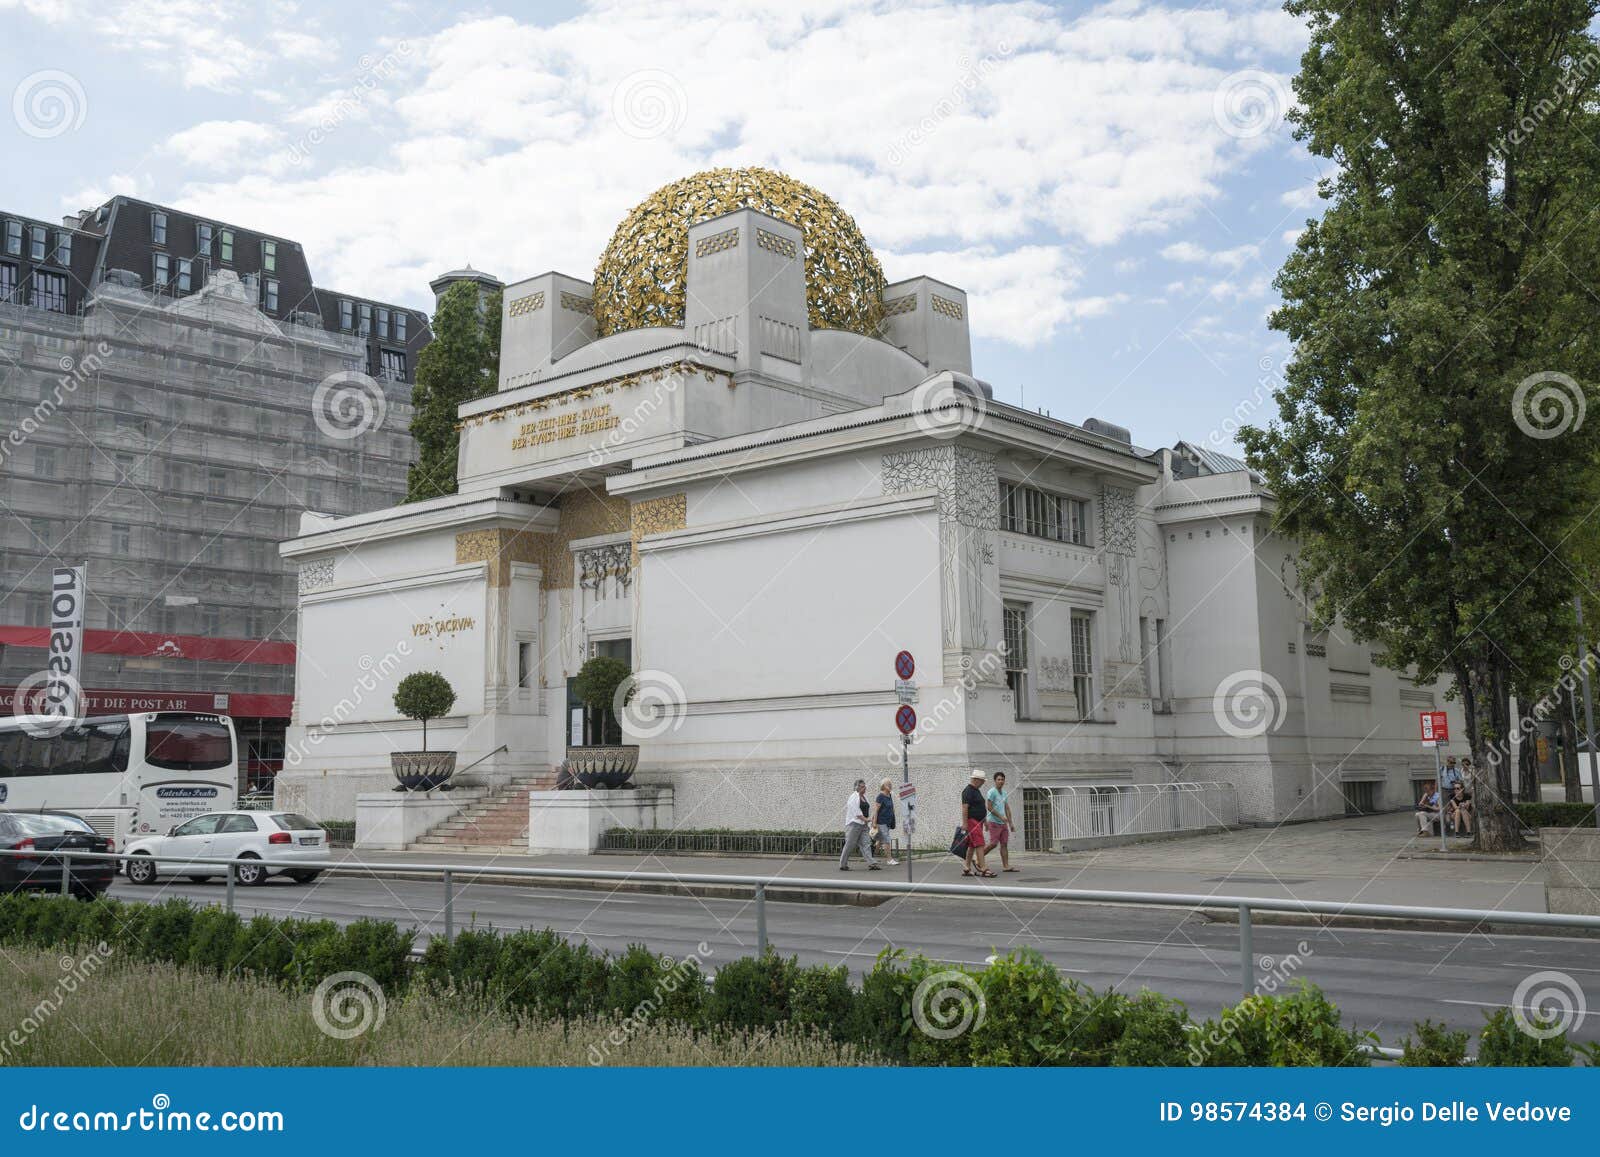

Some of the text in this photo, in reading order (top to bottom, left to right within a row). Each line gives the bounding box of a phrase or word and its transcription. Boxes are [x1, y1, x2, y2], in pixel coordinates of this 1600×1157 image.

[512, 437, 527, 450] DER
[580, 416, 619, 435] FREIHEIT
[520, 423, 536, 435] DER
[539, 418, 555, 431] ZEIT
[412, 624, 431, 636] VER
[104, 698, 126, 709] DIE
[131, 699, 163, 710] POST
[166, 700, 187, 710] AB!
